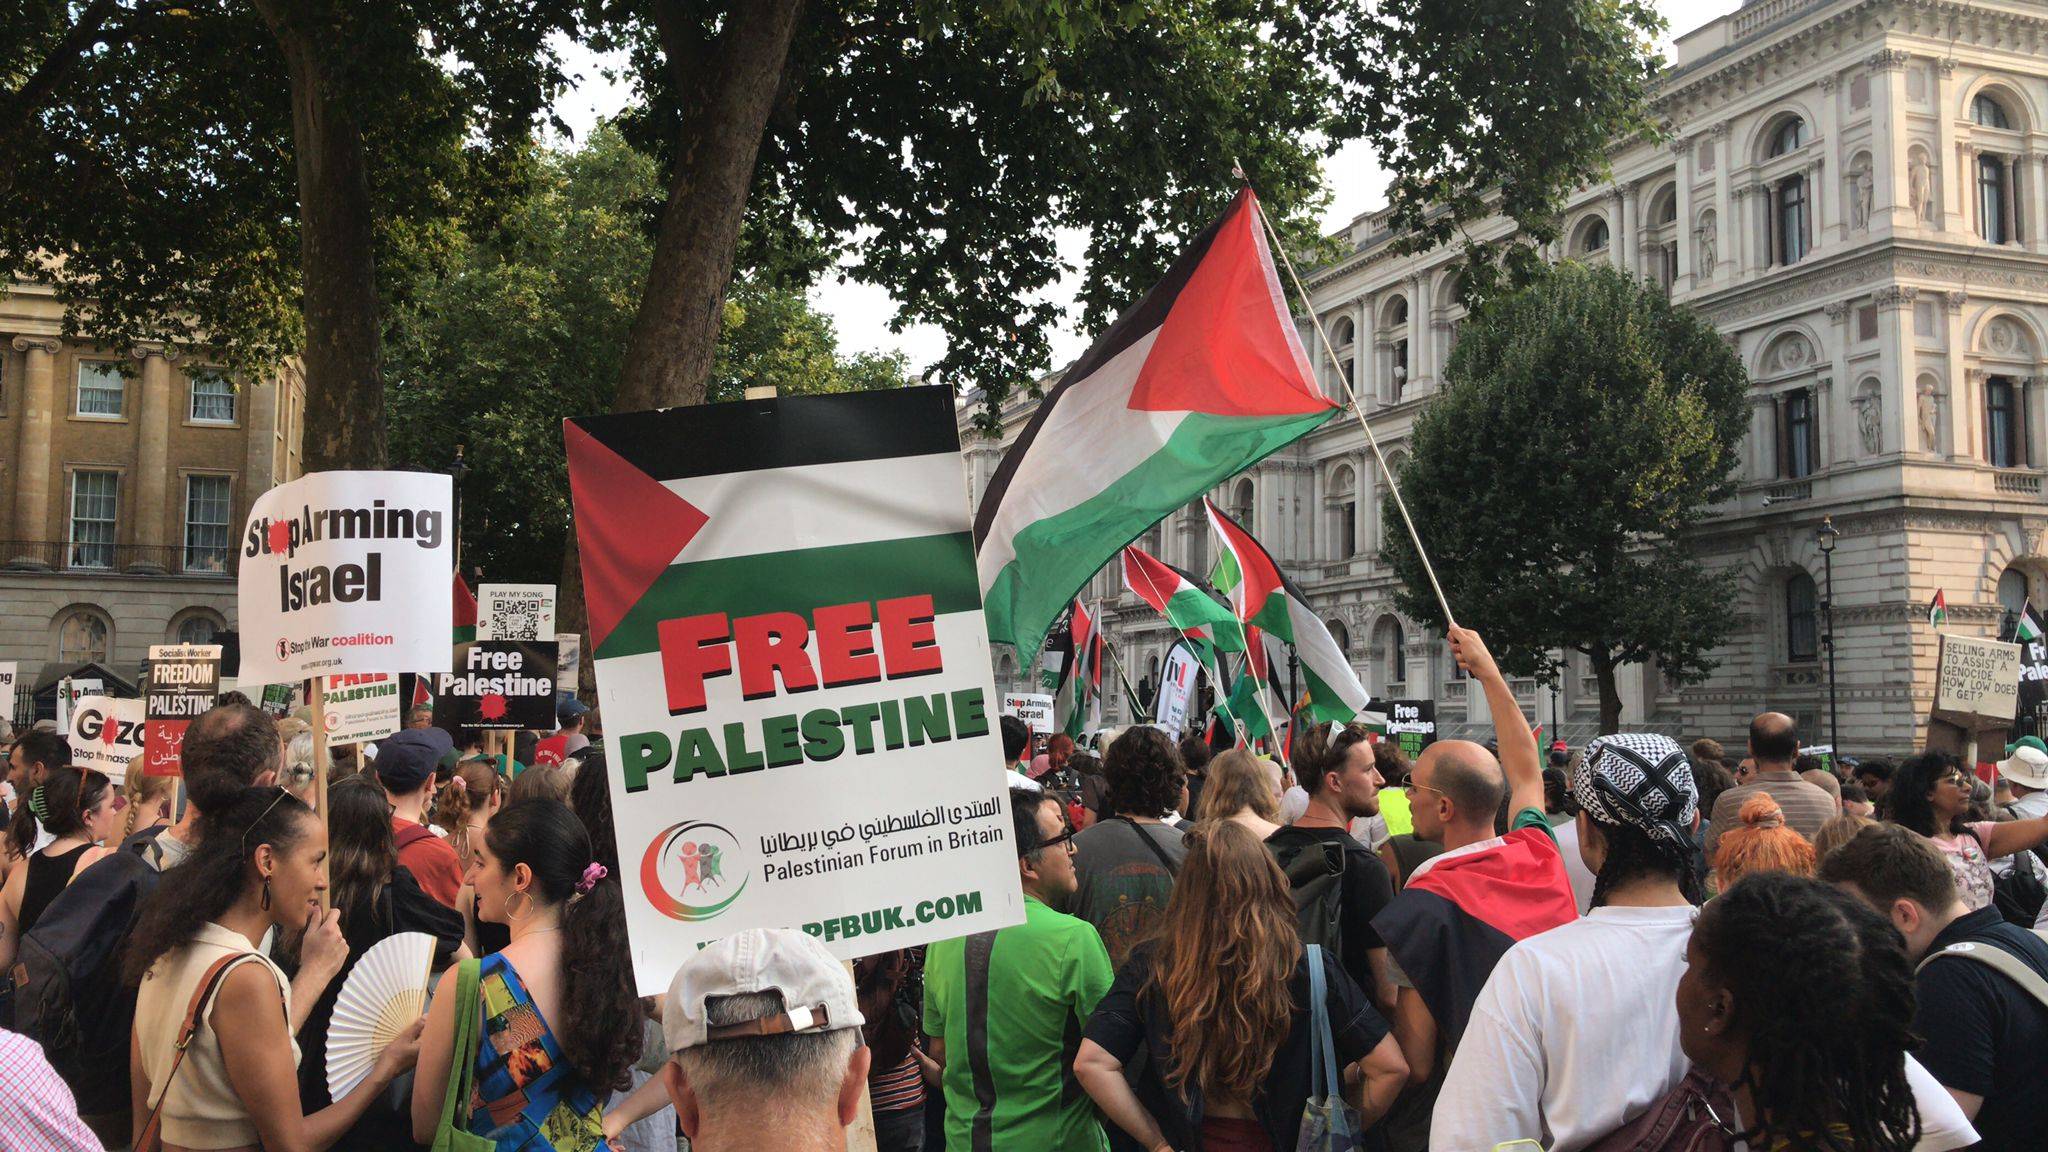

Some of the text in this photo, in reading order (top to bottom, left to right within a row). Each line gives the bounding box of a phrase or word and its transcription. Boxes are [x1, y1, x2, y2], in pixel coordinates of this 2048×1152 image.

[302, 499, 442, 549] Arming
[280, 552, 381, 613] Israel
[187, 648, 212, 657] Worker
[290, 642, 304, 654] Stop
[311, 636, 329, 648] War
[332, 633, 393, 647] coalition
[1946, 642, 2015, 661] SELLING ARMS
[468, 647, 522, 670] Free
[657, 594, 943, 716] FREE
[1946, 654, 2008, 672] TO ASSIST A
[154, 664, 213, 684] FREEDOM
[178, 684, 188, 694] for
[439, 673, 552, 697] Palestine
[1942, 677, 2016, 696] HOW LOW DOES
[1942, 688, 1952, 698] IT
[149, 695, 214, 715] PALESTINE
[1016, 709, 1044, 719] Israel
[1026, 699, 1052, 710] Arming
[1394, 704, 1418, 718] Free
[619, 687, 989, 793] PALESTINE
[74, 748, 95, 760] Stop
[760, 796, 1002, 858] المنتدى الفلسطيني في بريطانيا
[764, 826, 1004, 882] Palestinian Forum in Britain
[802, 891, 983, 942] PFBUK.COM
